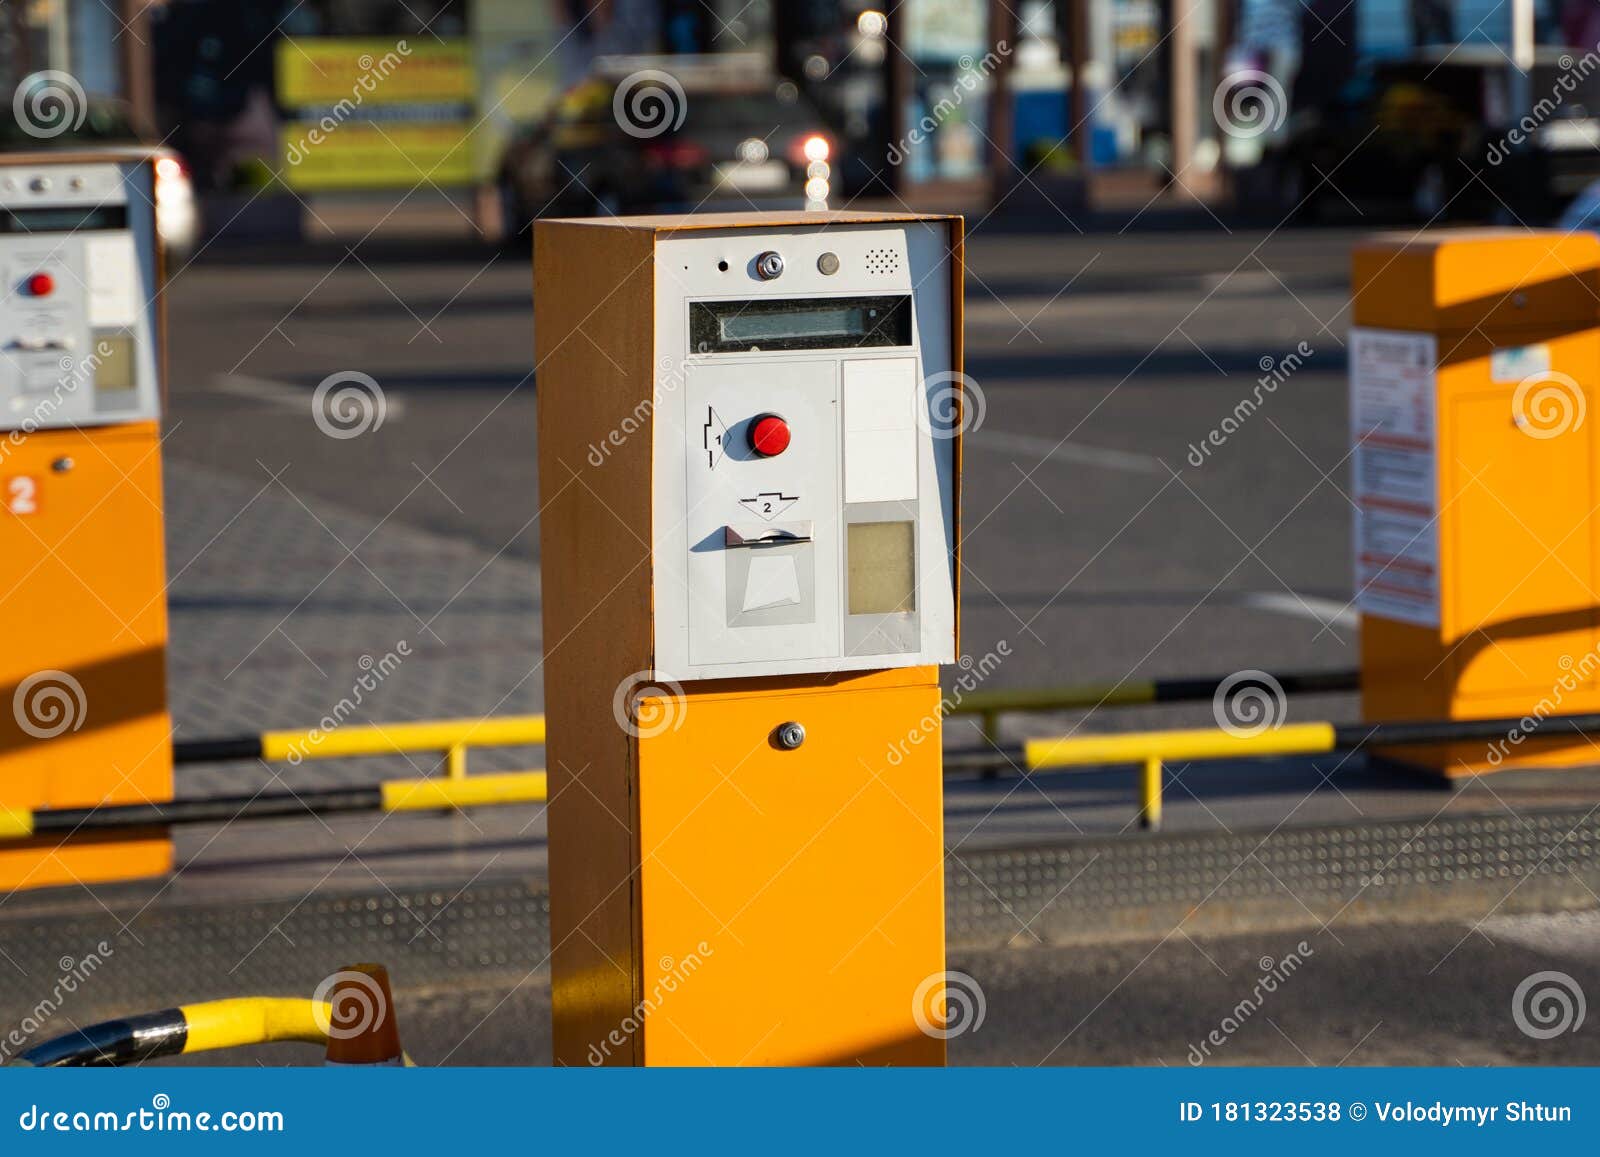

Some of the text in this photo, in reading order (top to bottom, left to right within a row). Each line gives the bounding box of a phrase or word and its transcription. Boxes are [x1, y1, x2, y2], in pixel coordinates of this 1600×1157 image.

[715, 435, 721, 445] 1
[10, 476, 36, 513] 2
[763, 503, 772, 513] 2
